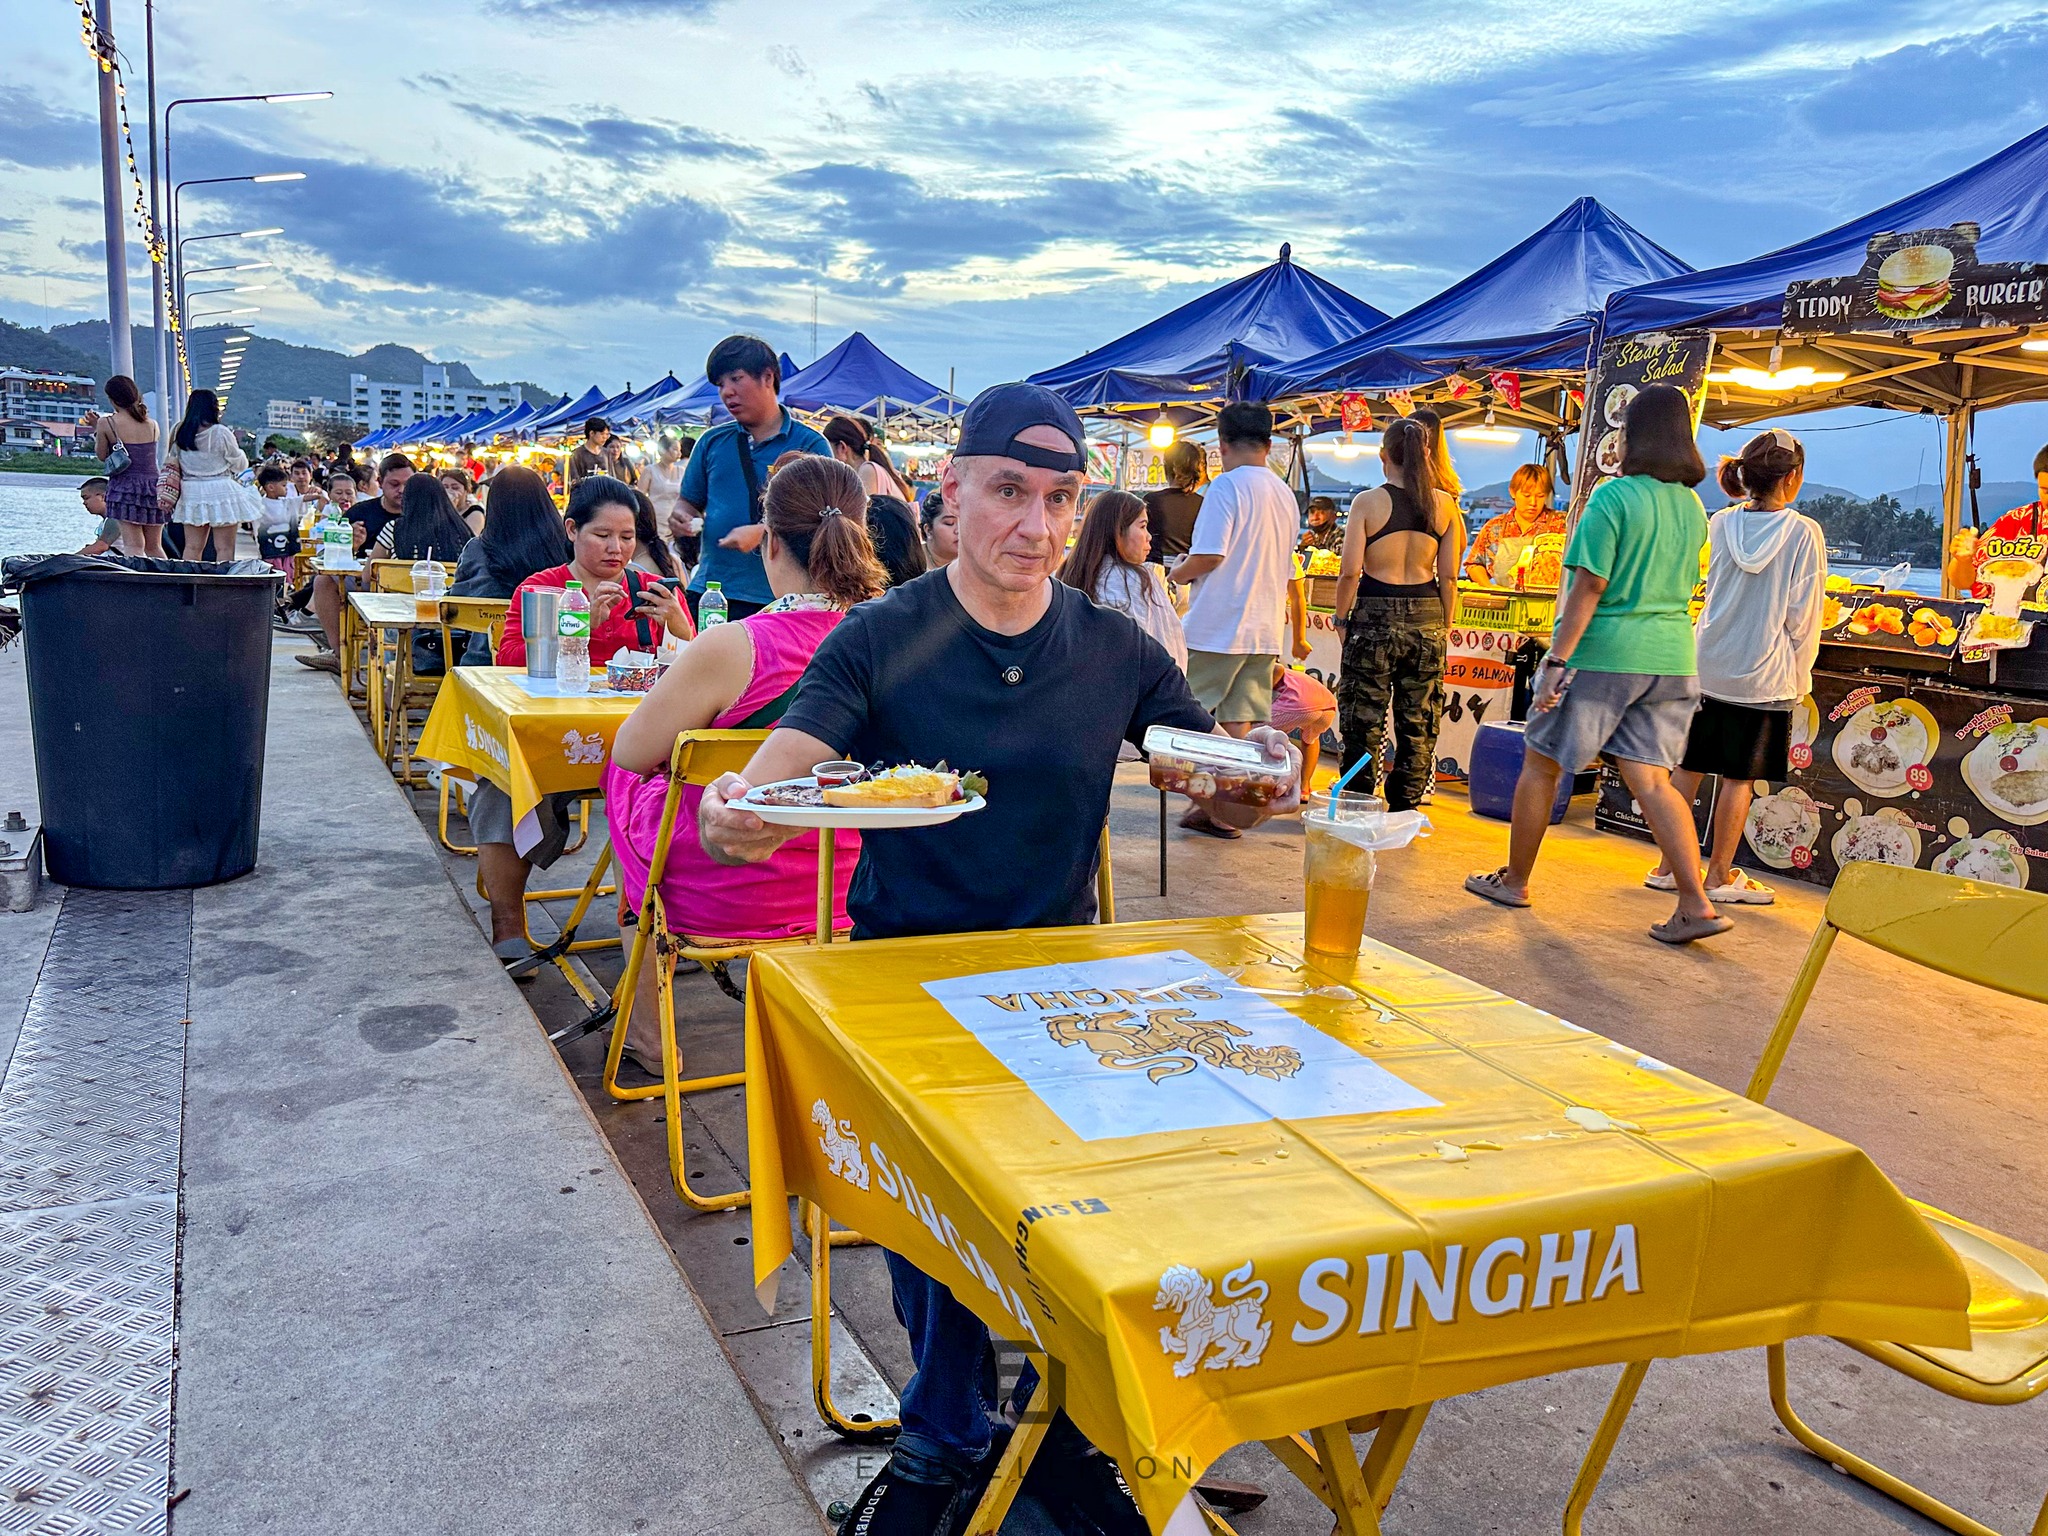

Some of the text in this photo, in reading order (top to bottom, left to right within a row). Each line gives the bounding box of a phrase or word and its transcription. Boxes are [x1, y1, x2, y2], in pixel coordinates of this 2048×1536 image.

[1797, 280, 2043, 318] TEDDY BURGER
[1616, 341, 1664, 367] Steak
[1641, 350, 1690, 383] Salad
[1472, 667, 1514, 683] SALMON
[1847, 687, 1880, 701] Chicken
[1792, 747, 1809, 760] 89
[1910, 768, 1928, 783] 89
[1614, 811, 1643, 825] Chicken
[1794, 849, 1808, 862] 50
[979, 985, 1223, 1012] SINGHA
[870, 1142, 1048, 1358] SINGHA
[1291, 1223, 1641, 1344] SINGHA
